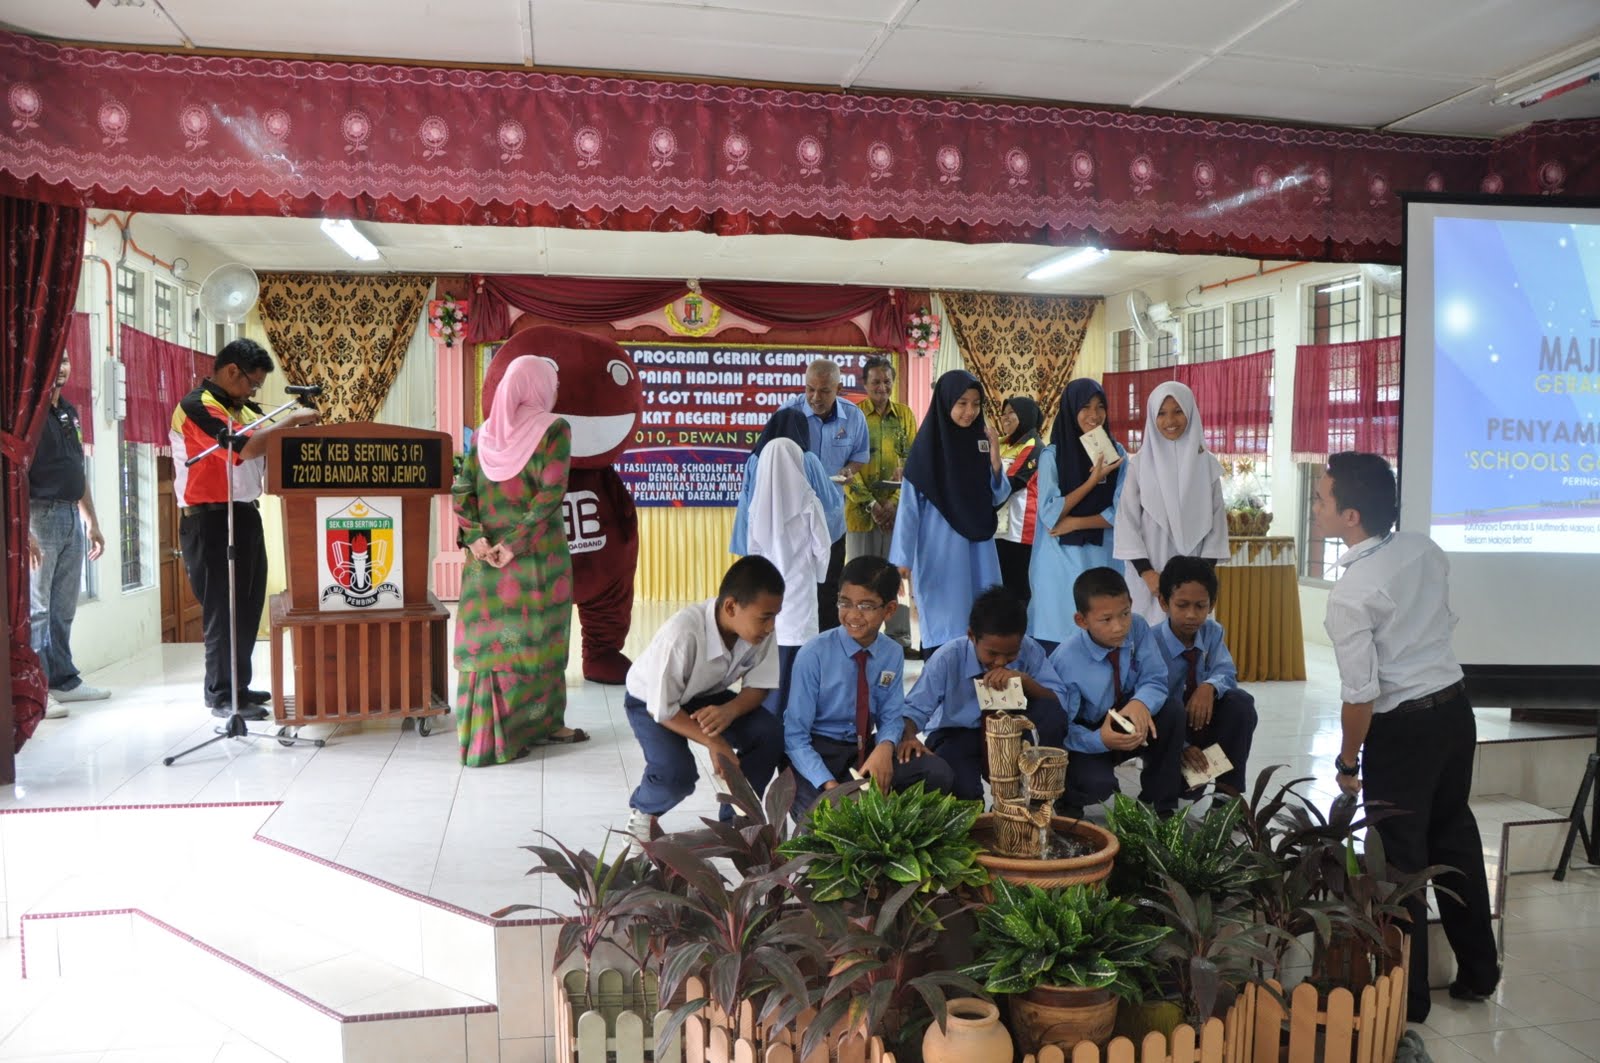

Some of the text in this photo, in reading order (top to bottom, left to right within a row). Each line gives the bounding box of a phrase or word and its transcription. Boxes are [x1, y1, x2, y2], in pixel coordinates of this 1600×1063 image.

[634, 350, 709, 364] PROGRAM
[713, 352, 761, 365] GERAK
[1539, 335, 1600, 373] MAJ
[639, 370, 681, 384] PAIAN
[686, 372, 742, 384] HADIAH
[658, 391, 690, 404] GOT
[693, 392, 744, 405] TALENT
[642, 411, 773, 425] KAT NEGERI SEMBI
[635, 431, 671, 445] 010,
[679, 431, 737, 443] DEWAN
[1487, 418, 1600, 444] PENYAM
[300, 443, 423, 462] SEK KEB SERTING 3 (F)
[292, 465, 426, 483] 72120 BANDAR SRI JEMPO
[624, 464, 679, 473] FASILITATOR
[682, 464, 732, 472] SCHOOLNET
[649, 473, 741, 482] DENGAN KERJASAMA
[635, 482, 693, 491] KOMUNIKASI
[697, 482, 716, 491] DAN
[719, 482, 742, 491] MULT
[634, 492, 684, 501] PELAJARAN
[688, 492, 723, 501] DAERAH
[343, 520, 354, 528] KEB
[354, 520, 378, 528] SERTING
[379, 520, 382, 528] 3
[568, 540, 602, 550] OADBAND
